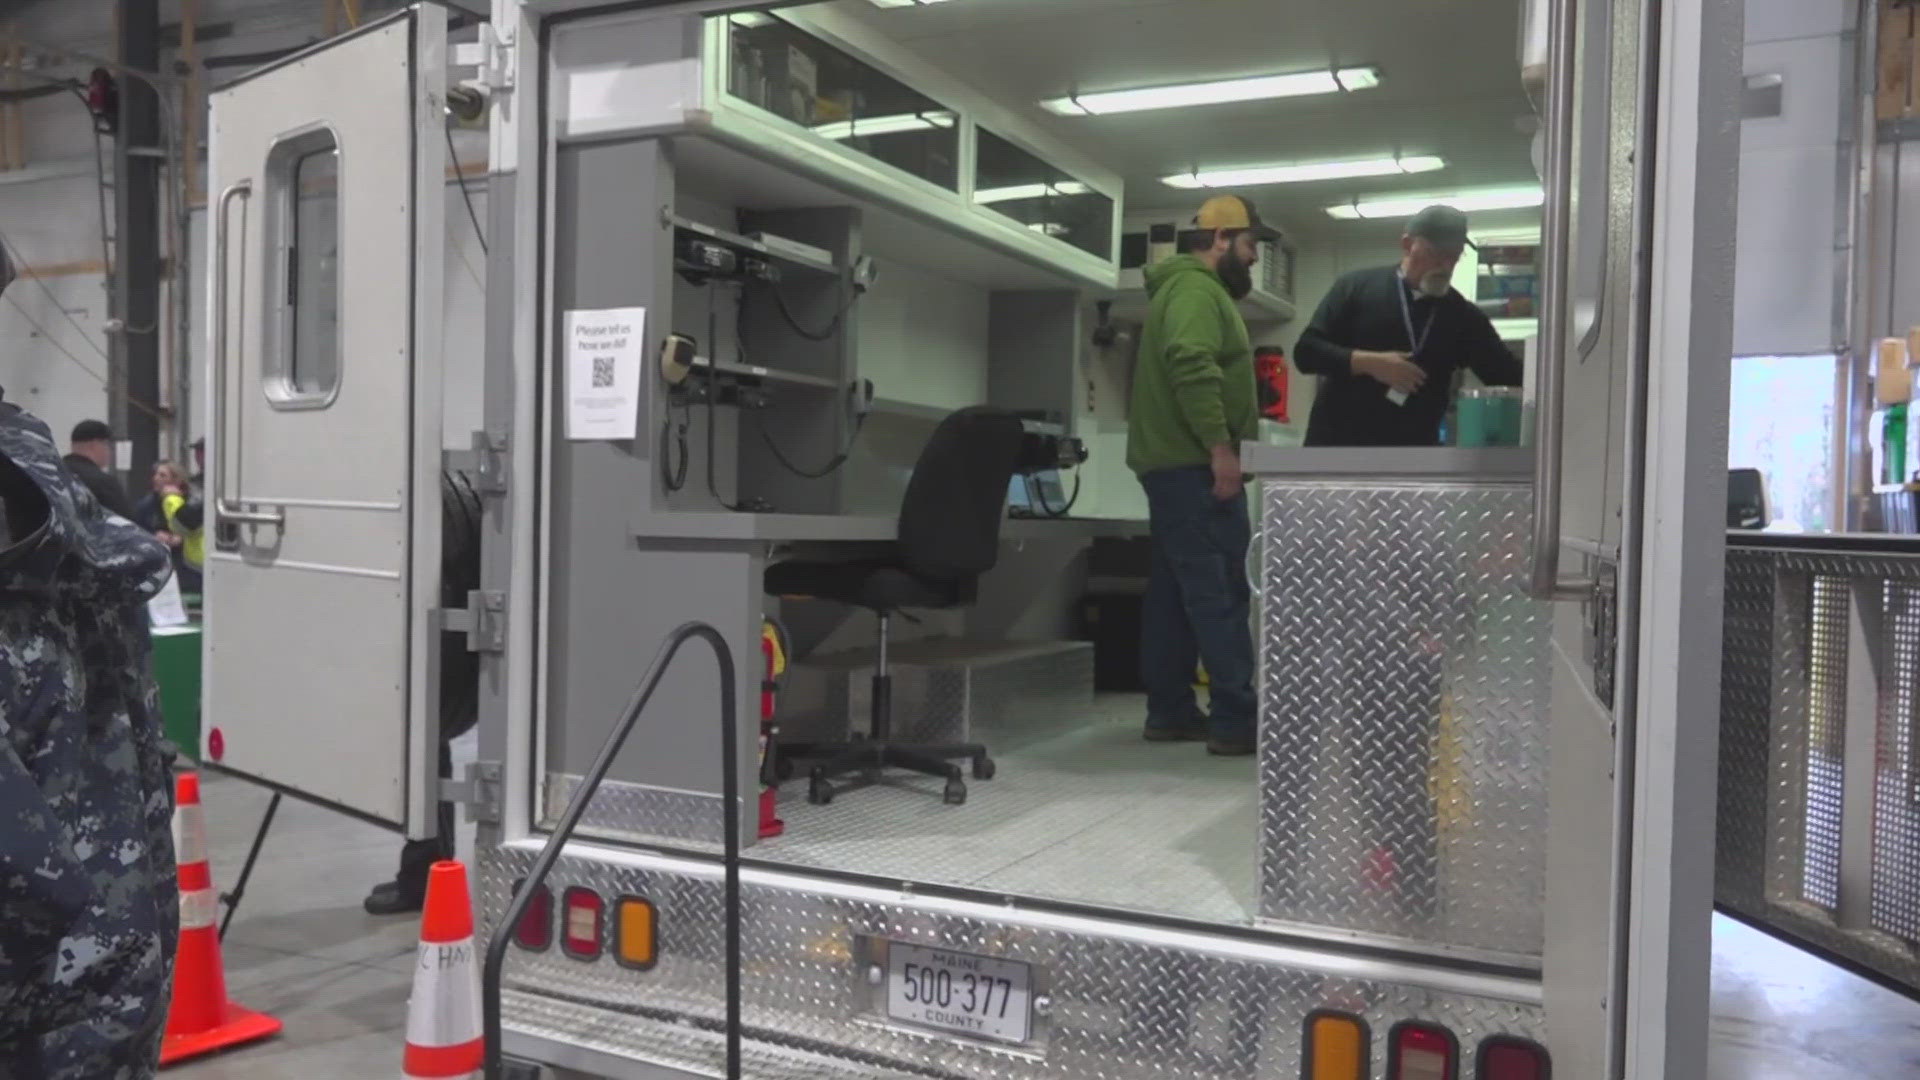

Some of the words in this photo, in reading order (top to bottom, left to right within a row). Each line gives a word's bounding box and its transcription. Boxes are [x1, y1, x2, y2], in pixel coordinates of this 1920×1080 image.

[575, 324, 607, 337] Please
[578, 340, 598, 350] how
[600, 341, 611, 350] we
[932, 953, 981, 972] MAINE
[925, 1010, 984, 1031] COUNTY
